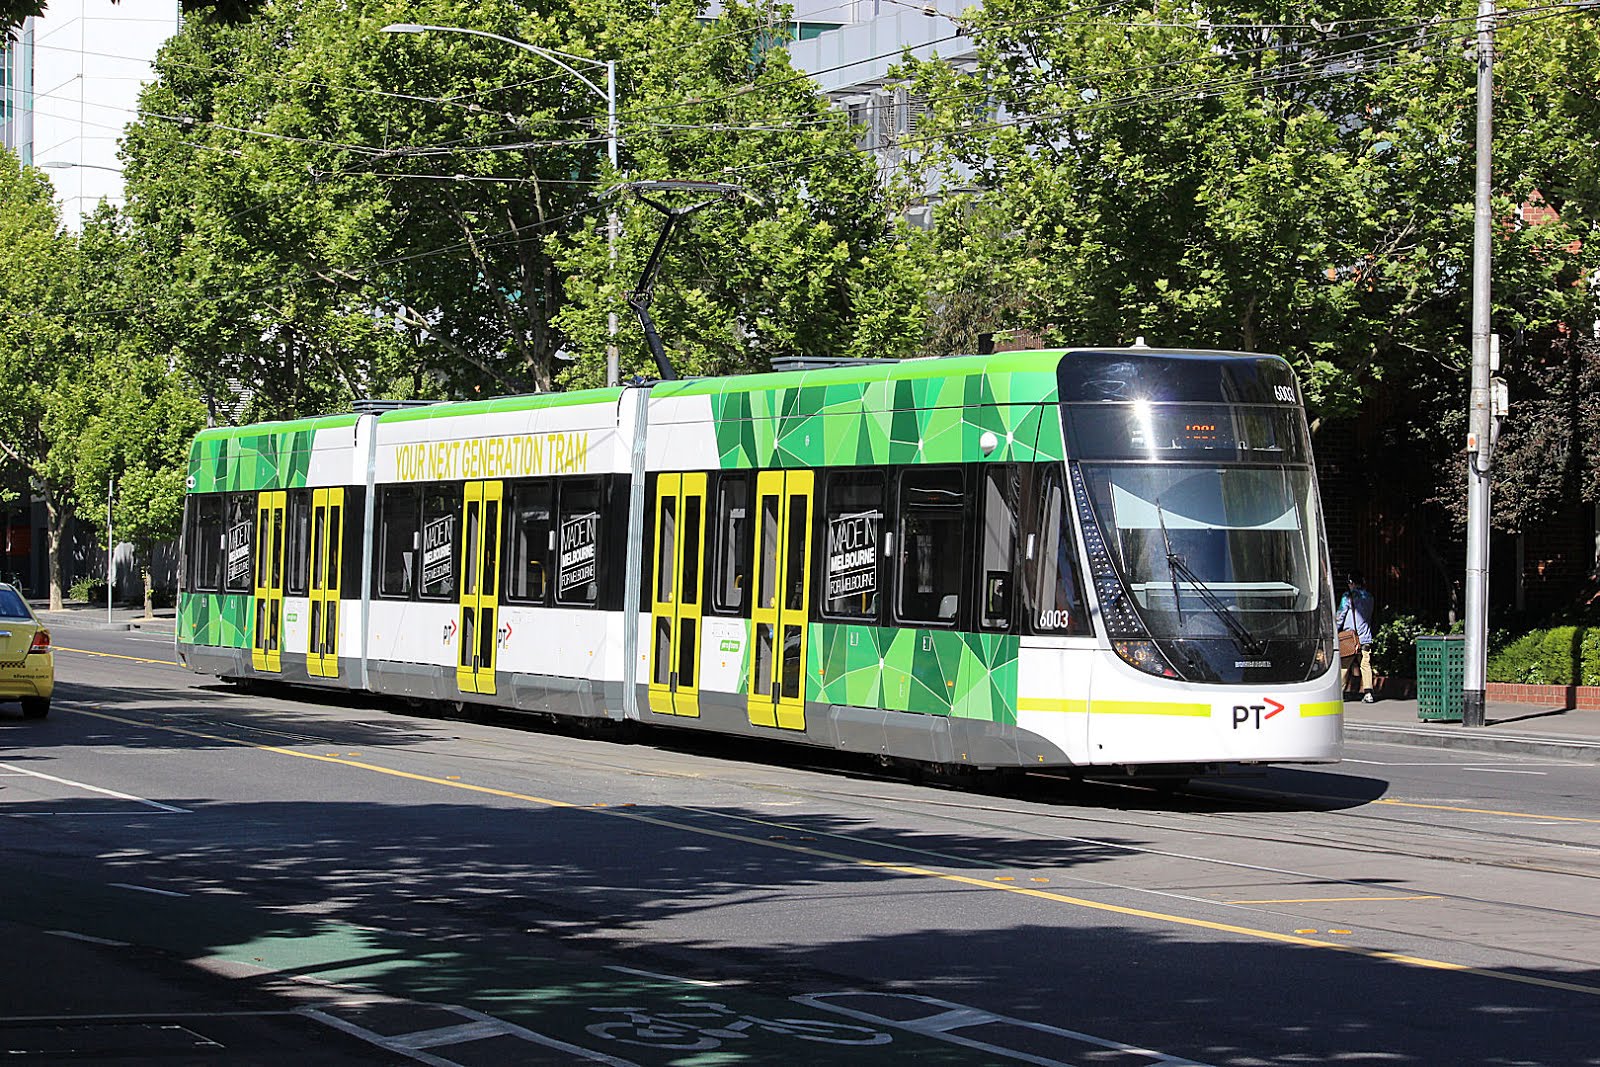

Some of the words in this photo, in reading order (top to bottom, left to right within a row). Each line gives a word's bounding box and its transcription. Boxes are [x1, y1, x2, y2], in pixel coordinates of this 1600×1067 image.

[1274, 385, 1295, 402] 6003
[395, 443, 425, 481] YOUR
[428, 441, 461, 479] NEXT
[461, 435, 544, 478] GENERATION
[547, 432, 588, 474] TRAM
[830, 519, 862, 552] MADE
[563, 544, 594, 567] MELBOURNE
[831, 546, 874, 572] MELBOURNE
[1040, 610, 1069, 628] 6003
